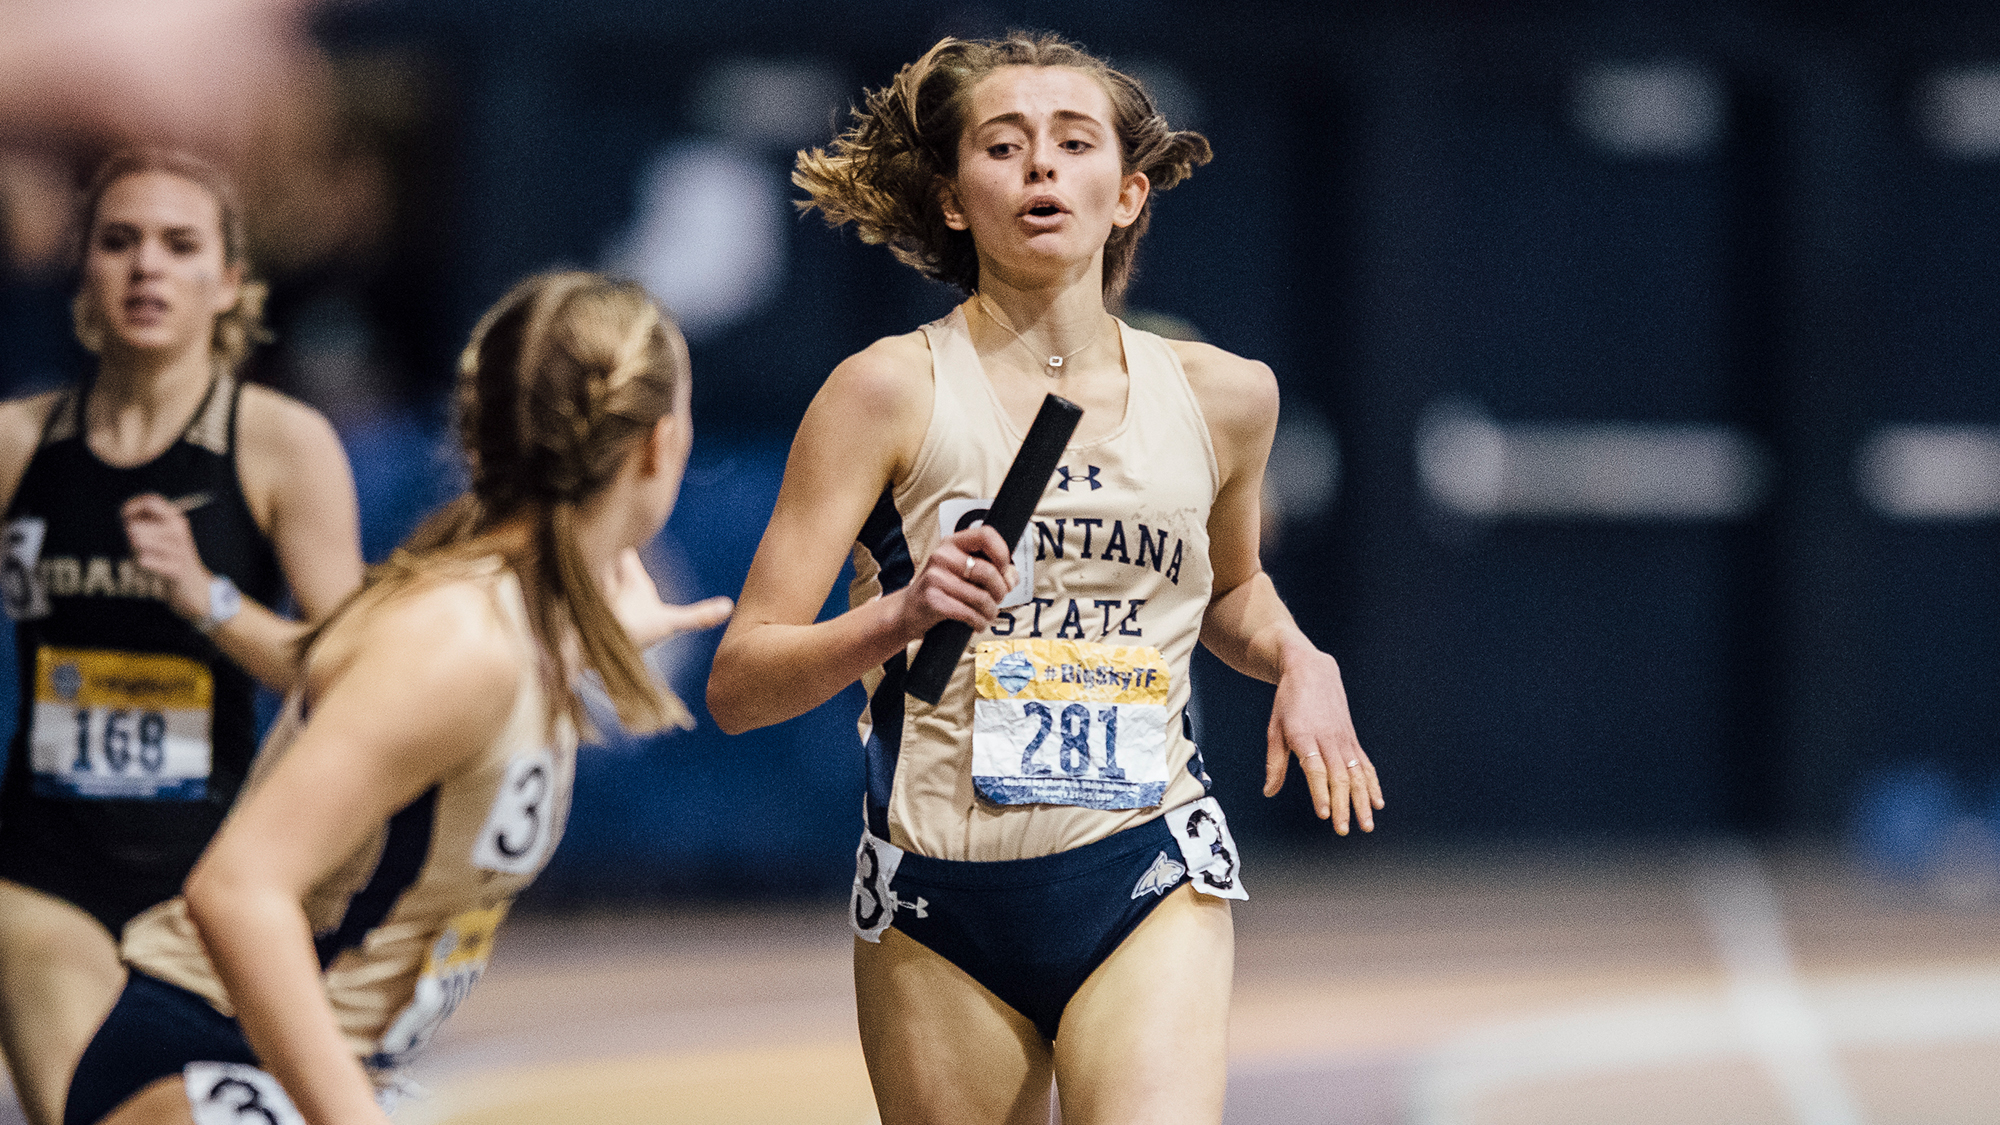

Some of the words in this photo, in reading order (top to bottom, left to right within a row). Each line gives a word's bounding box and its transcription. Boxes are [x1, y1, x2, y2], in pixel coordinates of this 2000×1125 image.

[1034, 517, 1184, 586] NTANA
[990, 598, 1147, 639] STATE
[1044, 664, 1158, 690] #BigSkyTF
[73, 709, 166, 773] 168
[1021, 701, 1126, 780] 281
[497, 765, 548, 858] 3
[855, 842, 883, 930] 3
[1186, 809, 1234, 890] 3
